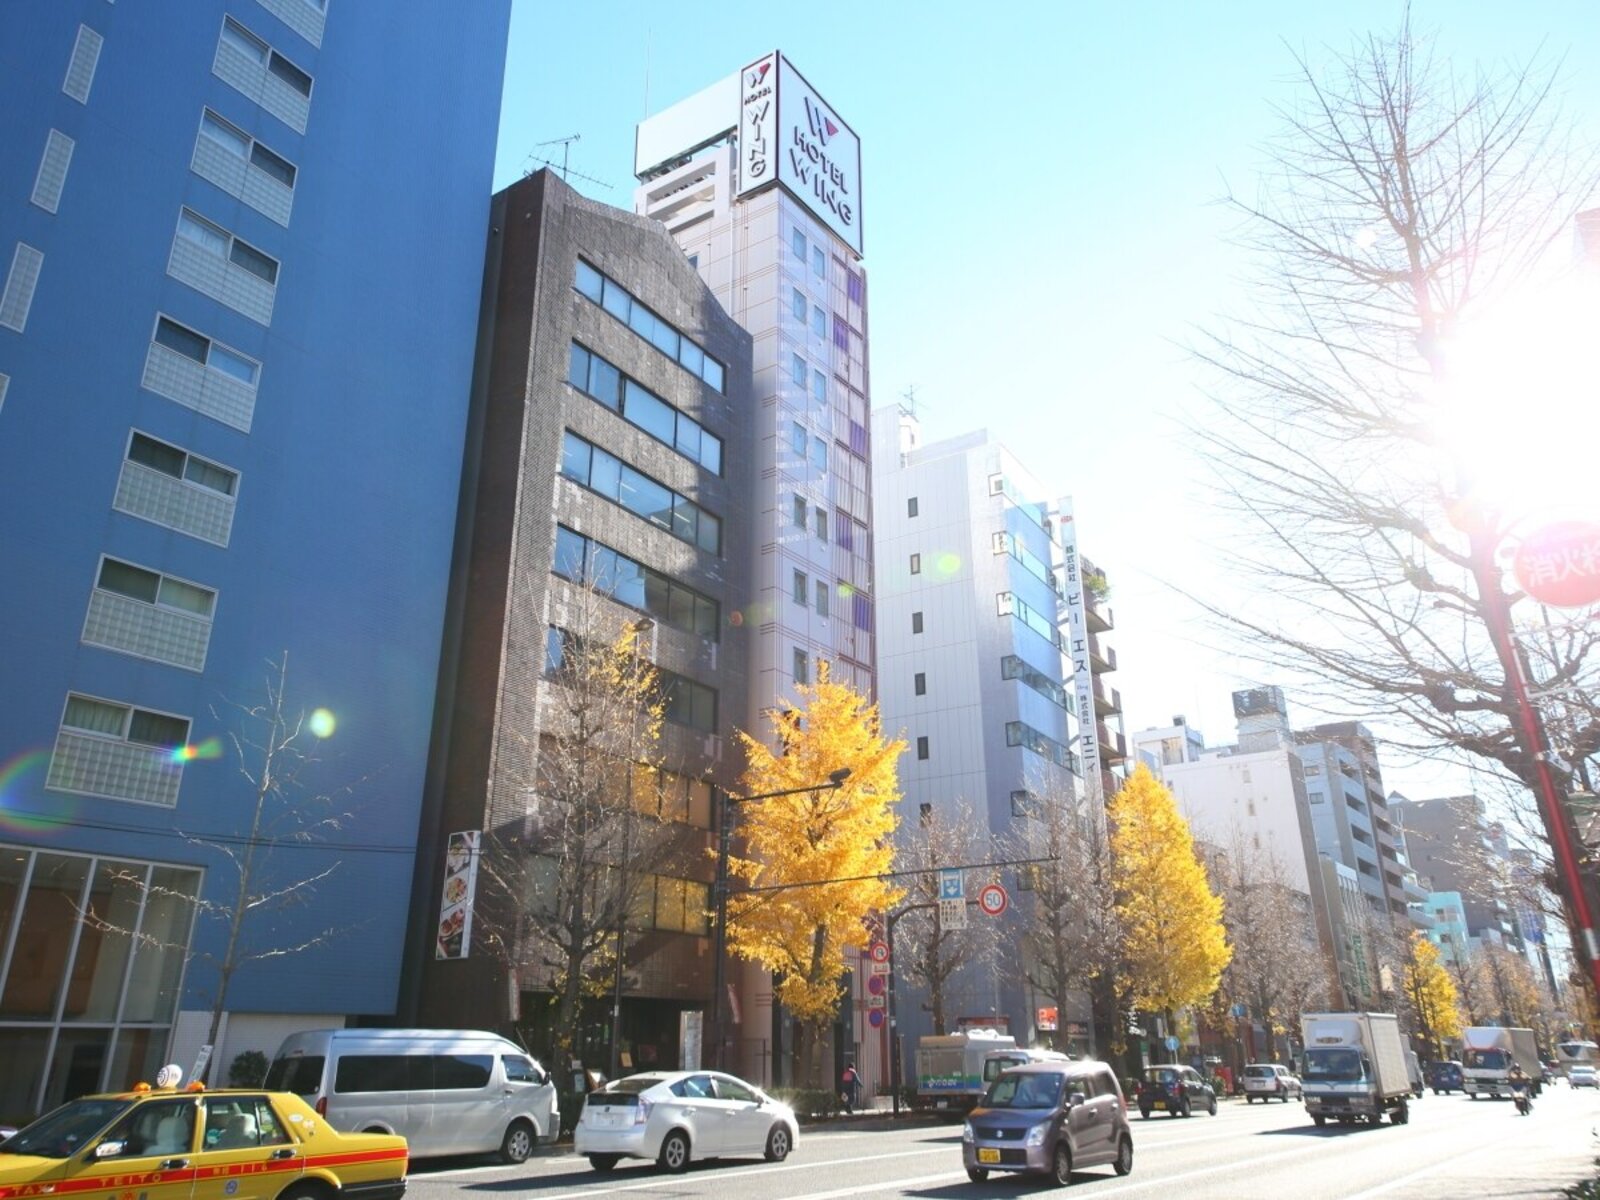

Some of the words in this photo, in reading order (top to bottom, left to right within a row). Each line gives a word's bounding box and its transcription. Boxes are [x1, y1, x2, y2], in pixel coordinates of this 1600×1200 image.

[744, 87, 772, 106] HOTEL
[747, 101, 769, 177] WING
[794, 125, 848, 195] HOTEL
[789, 147, 852, 226] WING
[986, 892, 1001, 907] 50
[101, 1174, 161, 1188] TEITO
